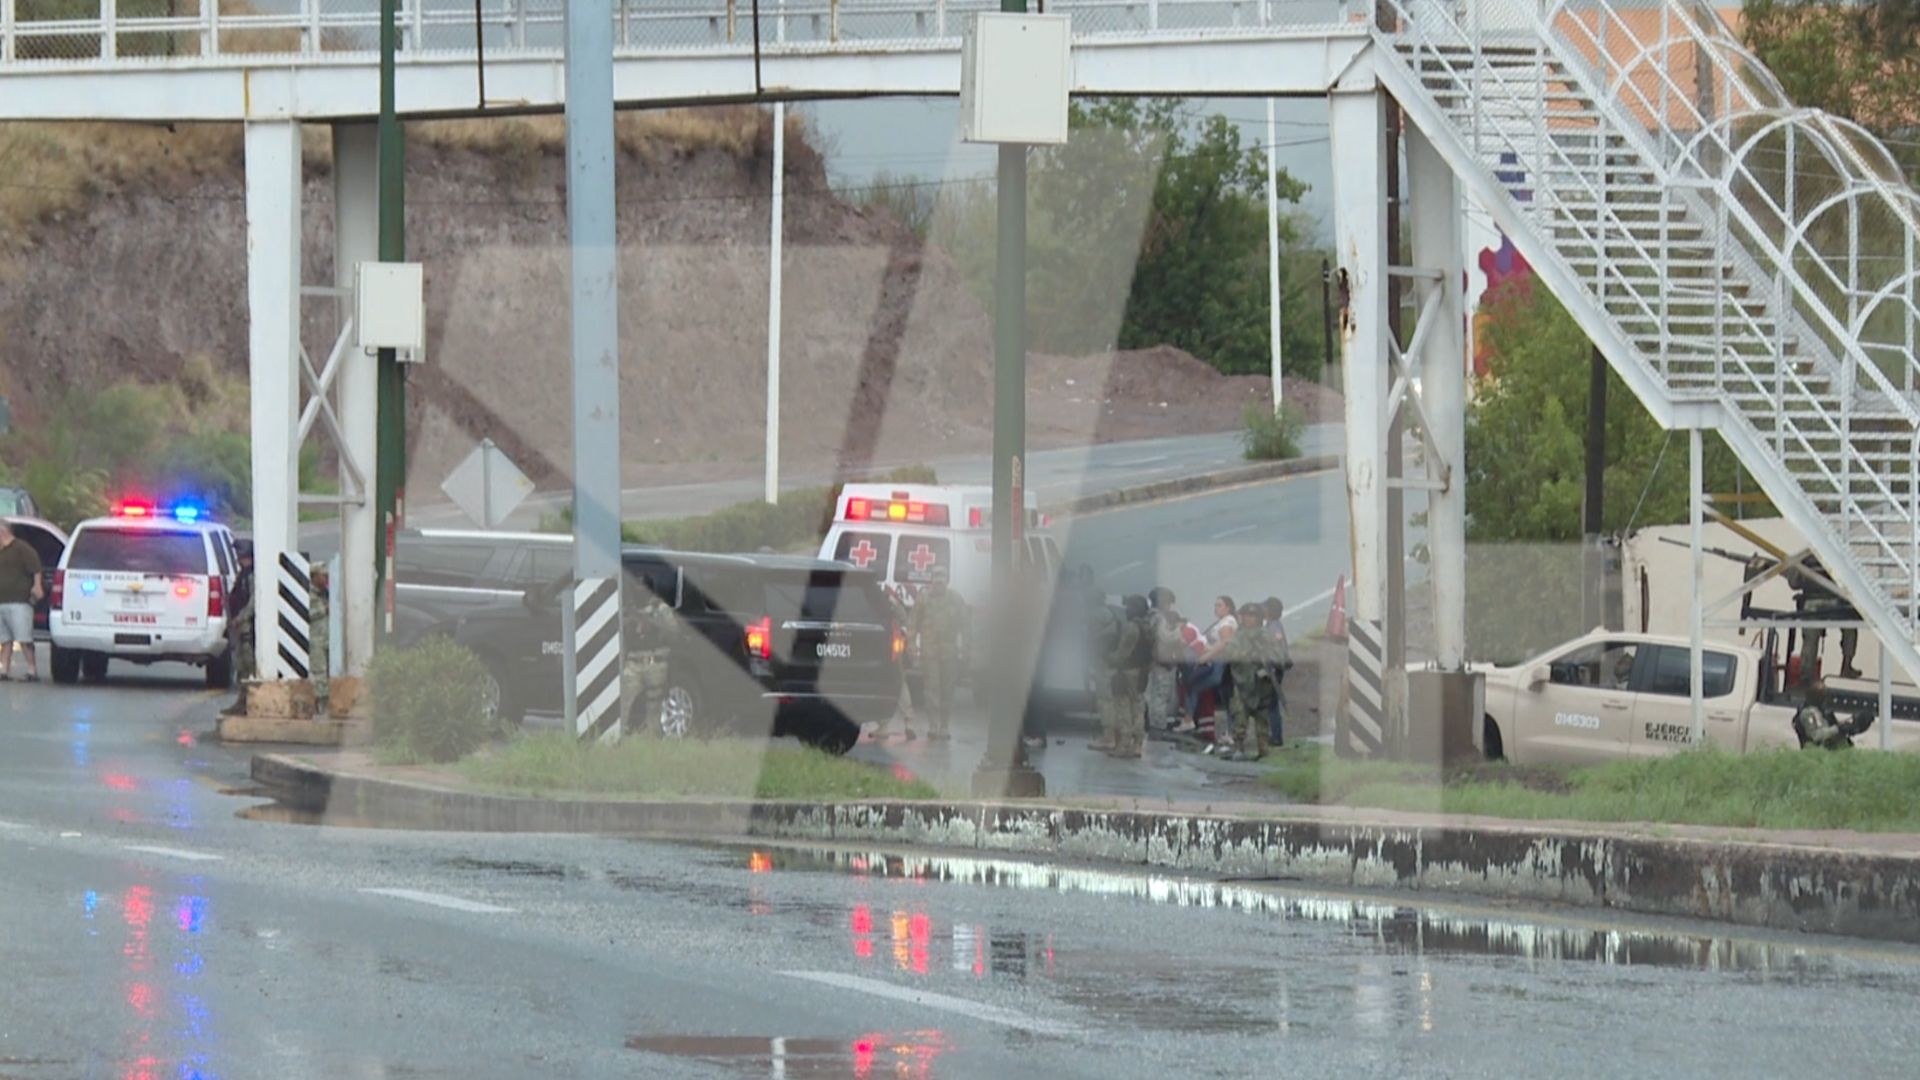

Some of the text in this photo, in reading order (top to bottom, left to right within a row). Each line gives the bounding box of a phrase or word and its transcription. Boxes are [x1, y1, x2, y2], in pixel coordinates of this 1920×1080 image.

[70, 611, 82, 620] 10
[113, 614, 157, 624] SANTA ANA
[816, 643, 851, 657] 0145121
[1555, 712, 1600, 729] 0145303
[1645, 732, 1692, 744] MEXICA
